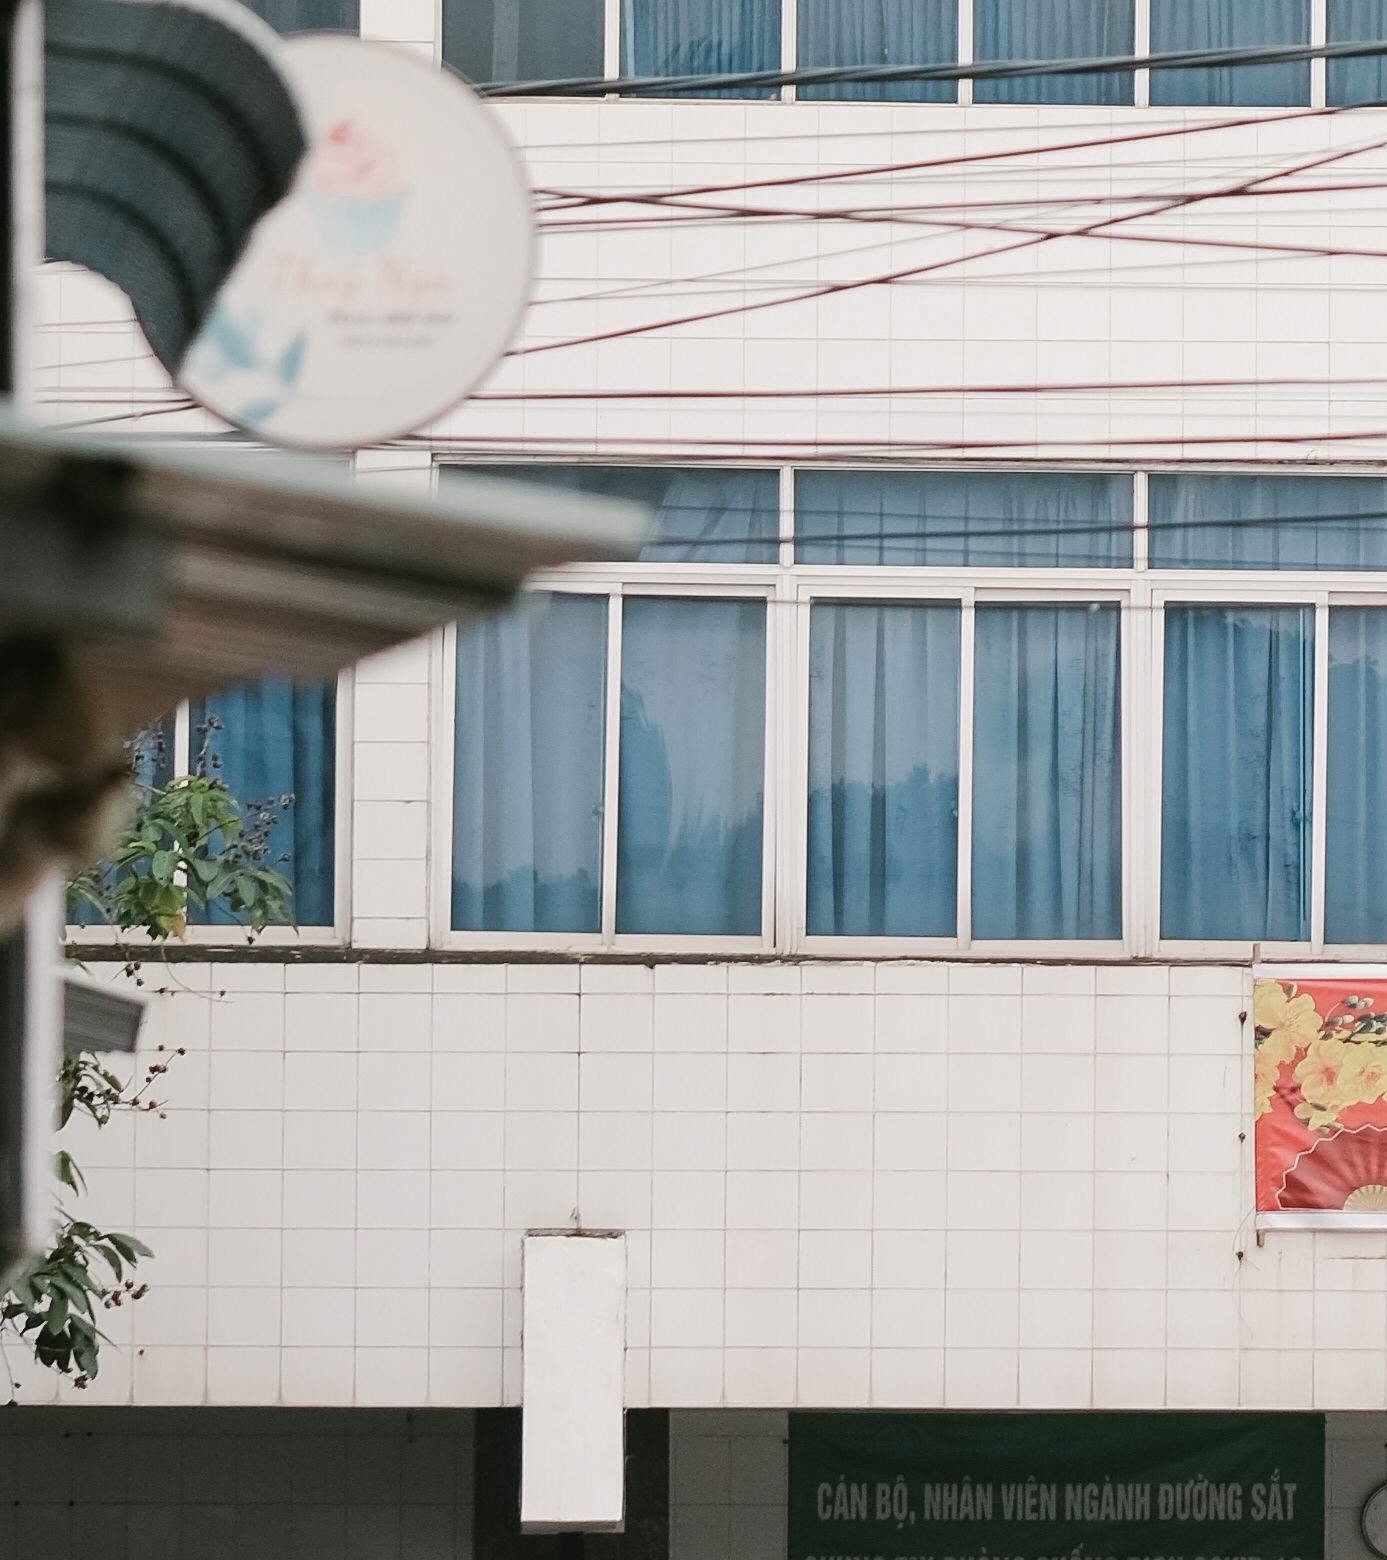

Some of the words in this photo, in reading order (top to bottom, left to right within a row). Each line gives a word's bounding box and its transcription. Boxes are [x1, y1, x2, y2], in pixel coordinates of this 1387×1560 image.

[817, 1471, 867, 1521] CÁN
[876, 1475, 917, 1530] BỘ,
[925, 1473, 993, 1521] NHÂN
[1000, 1473, 1056, 1521] VIÊN
[1065, 1473, 1151, 1521] NGÀNH
[1158, 1473, 1243, 1521] ĐƯỜNG
[1250, 1468, 1297, 1521] SẮT
